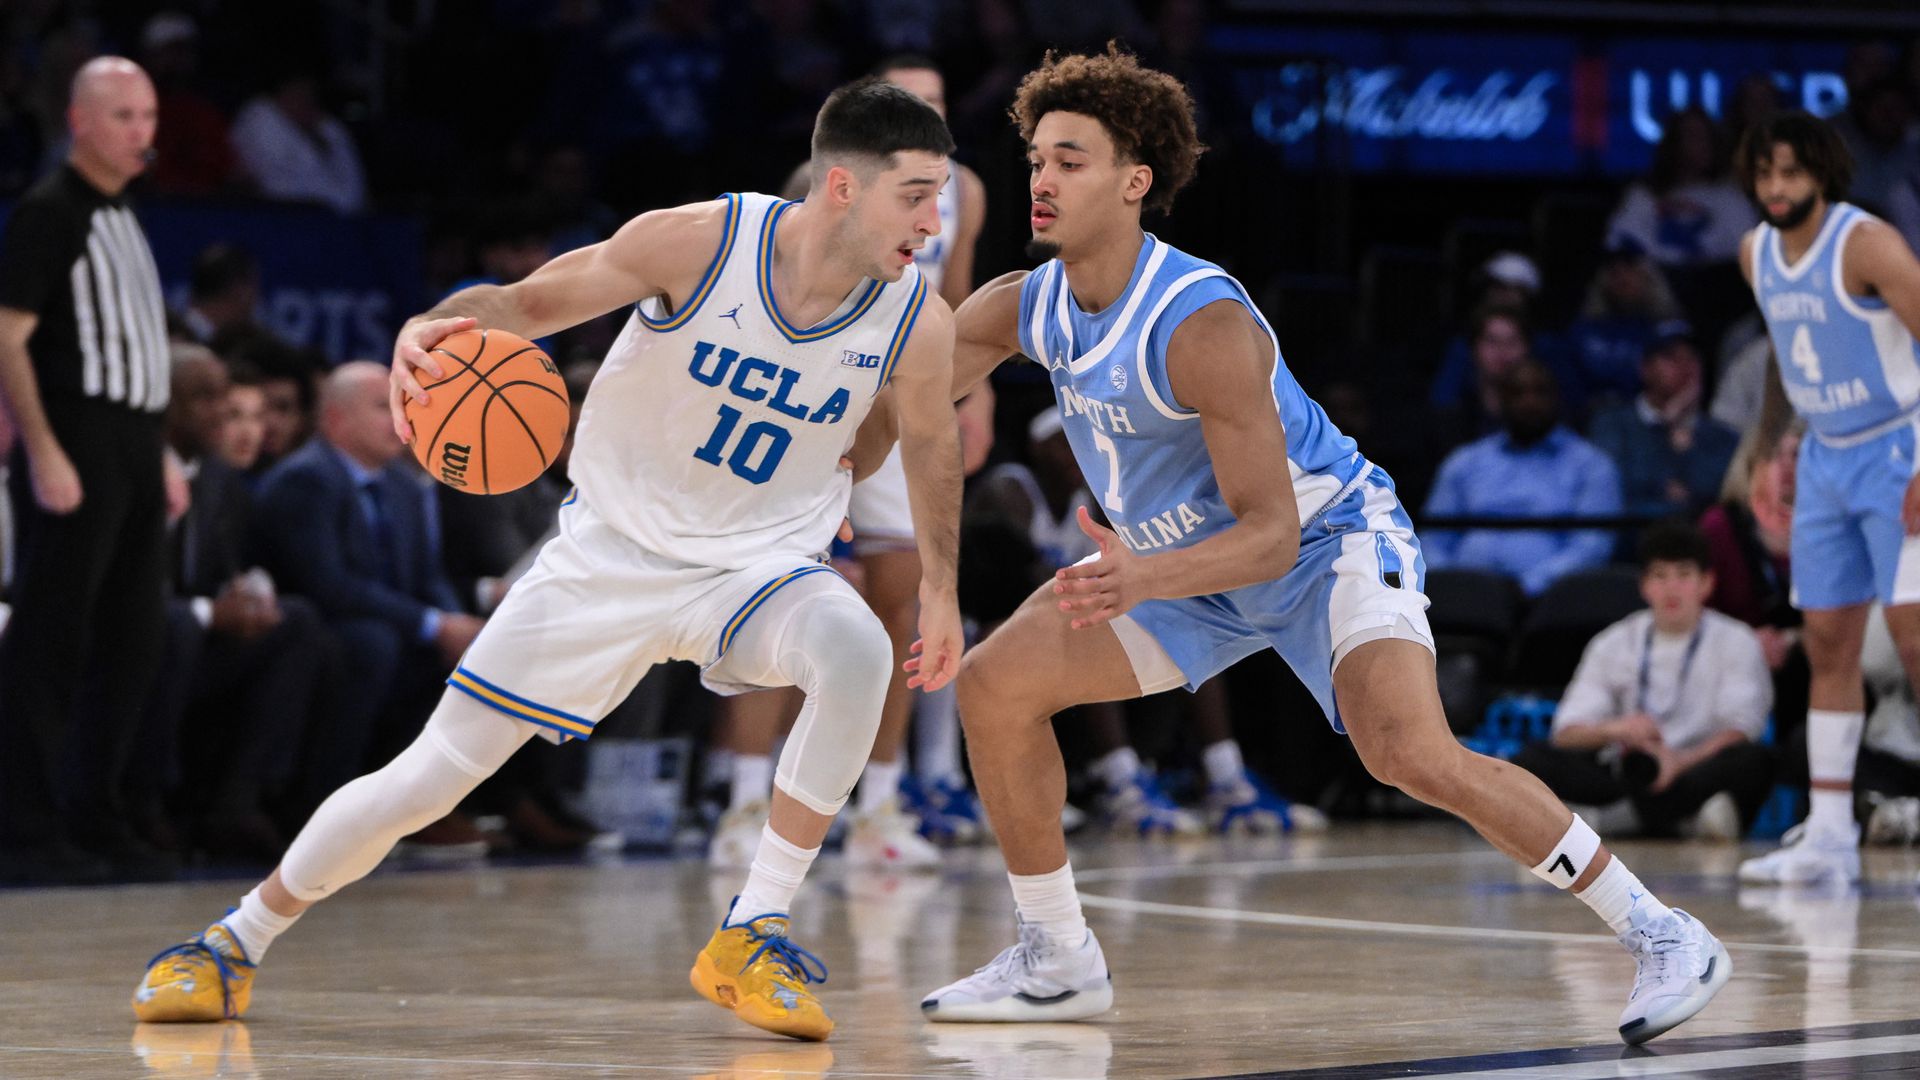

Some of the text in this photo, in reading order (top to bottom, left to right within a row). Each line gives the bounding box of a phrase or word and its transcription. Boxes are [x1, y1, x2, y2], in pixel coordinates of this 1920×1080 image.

[688, 340, 850, 424] UCLA
[1790, 322, 1823, 383] 4
[441, 441, 472, 487] Wil
[693, 403, 793, 485] 10
[1092, 429, 1123, 513] 7
[1547, 853, 1577, 878] 7
